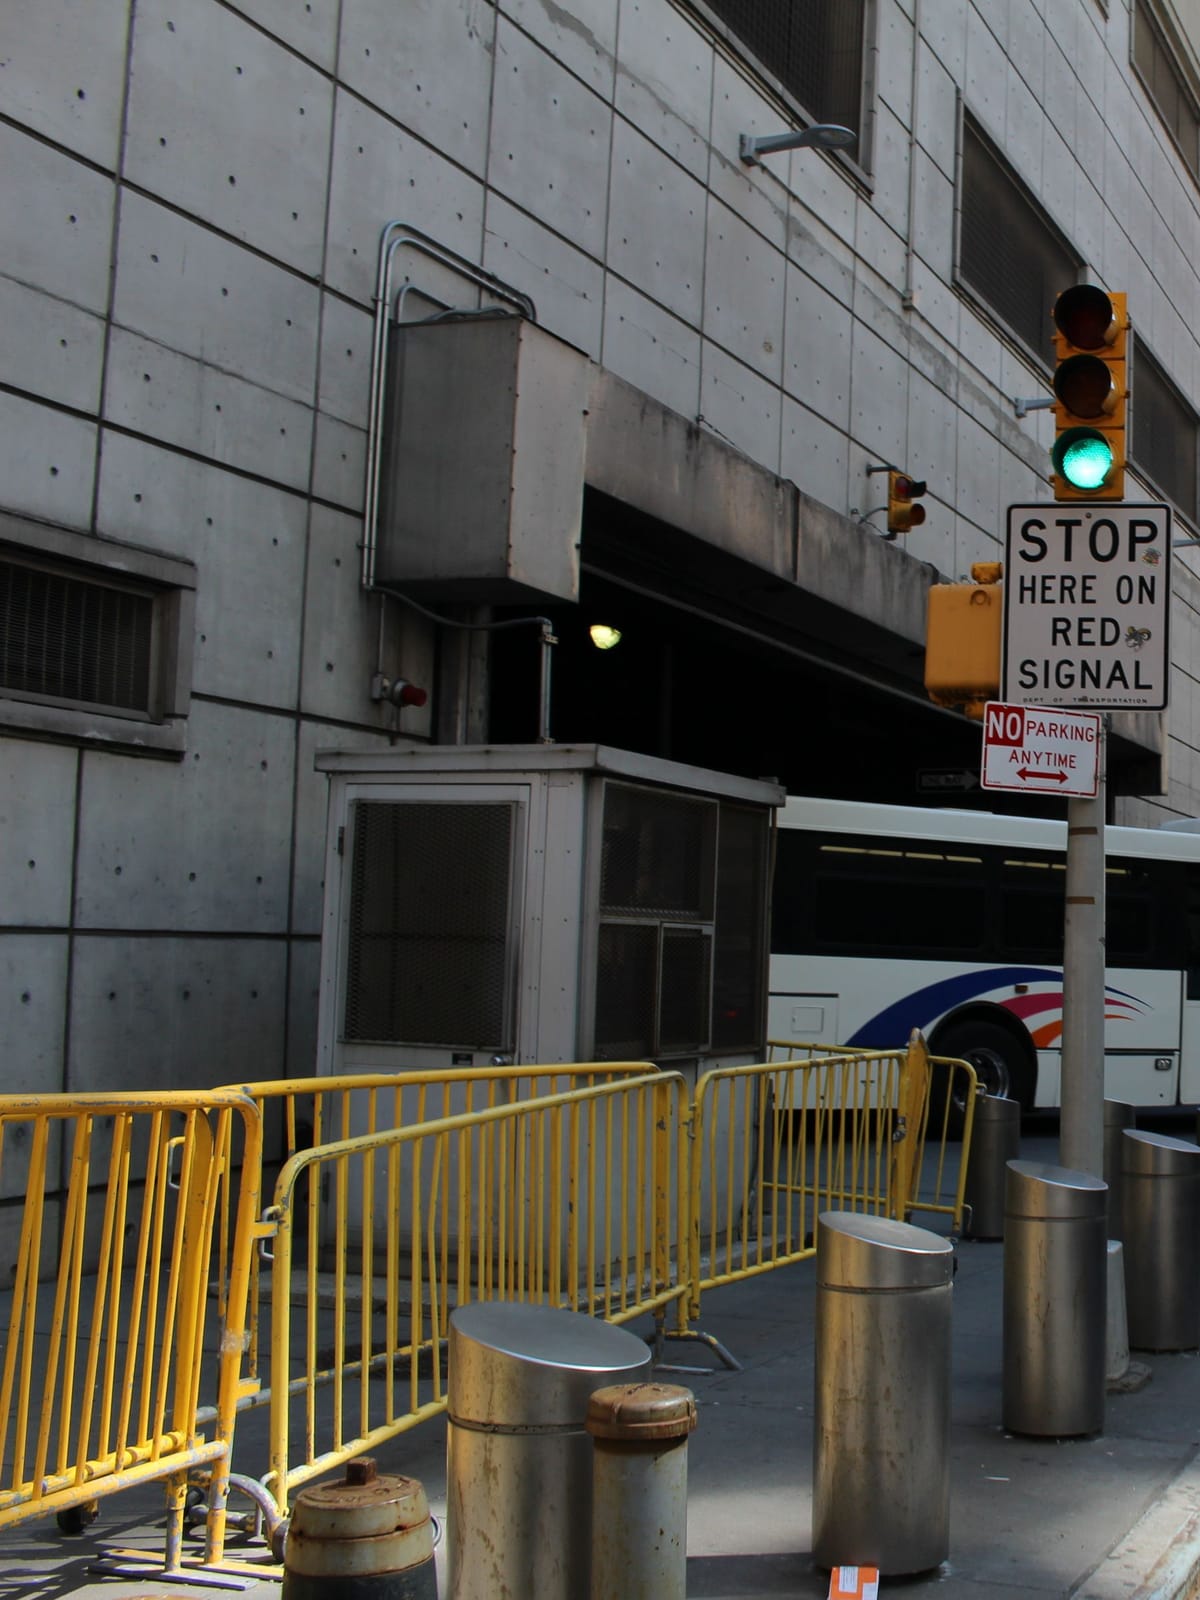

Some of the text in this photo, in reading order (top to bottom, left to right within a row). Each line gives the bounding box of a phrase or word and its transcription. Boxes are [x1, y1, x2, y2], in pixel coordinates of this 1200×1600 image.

[1018, 518, 1159, 563] STOP
[1019, 575, 1156, 605] HERE ON
[1052, 617, 1121, 646] RED
[1018, 659, 1153, 690] SIGNAL
[987, 710, 1095, 743] NO PARKING
[1009, 749, 1077, 769] ANYTIME
